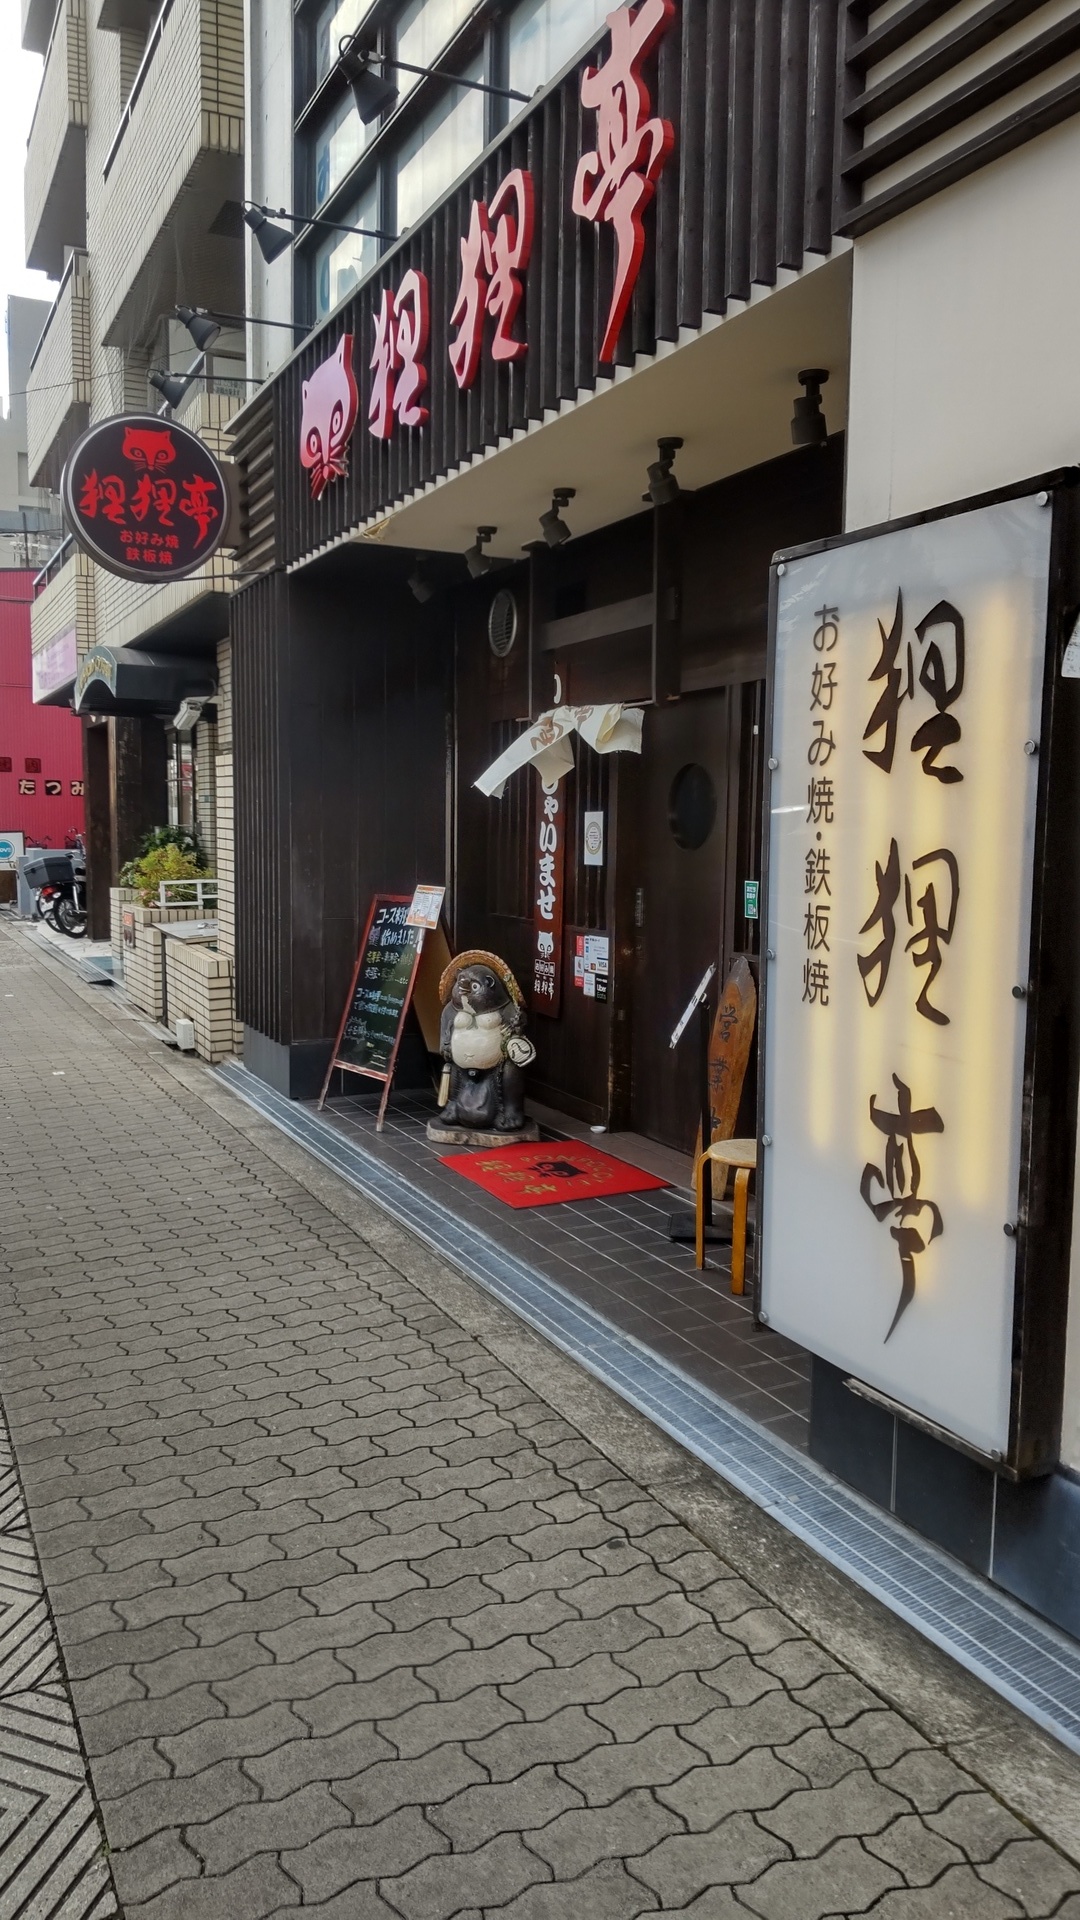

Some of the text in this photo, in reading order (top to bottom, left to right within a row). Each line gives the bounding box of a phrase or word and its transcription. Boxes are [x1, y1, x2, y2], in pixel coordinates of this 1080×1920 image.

[119, 530, 180, 549] お好み焼
[126, 548, 174, 566] 鉄板焼
[801, 604, 843, 1007] お好み焼・鉄板焼
[596, 984, 607, 993] Uber
